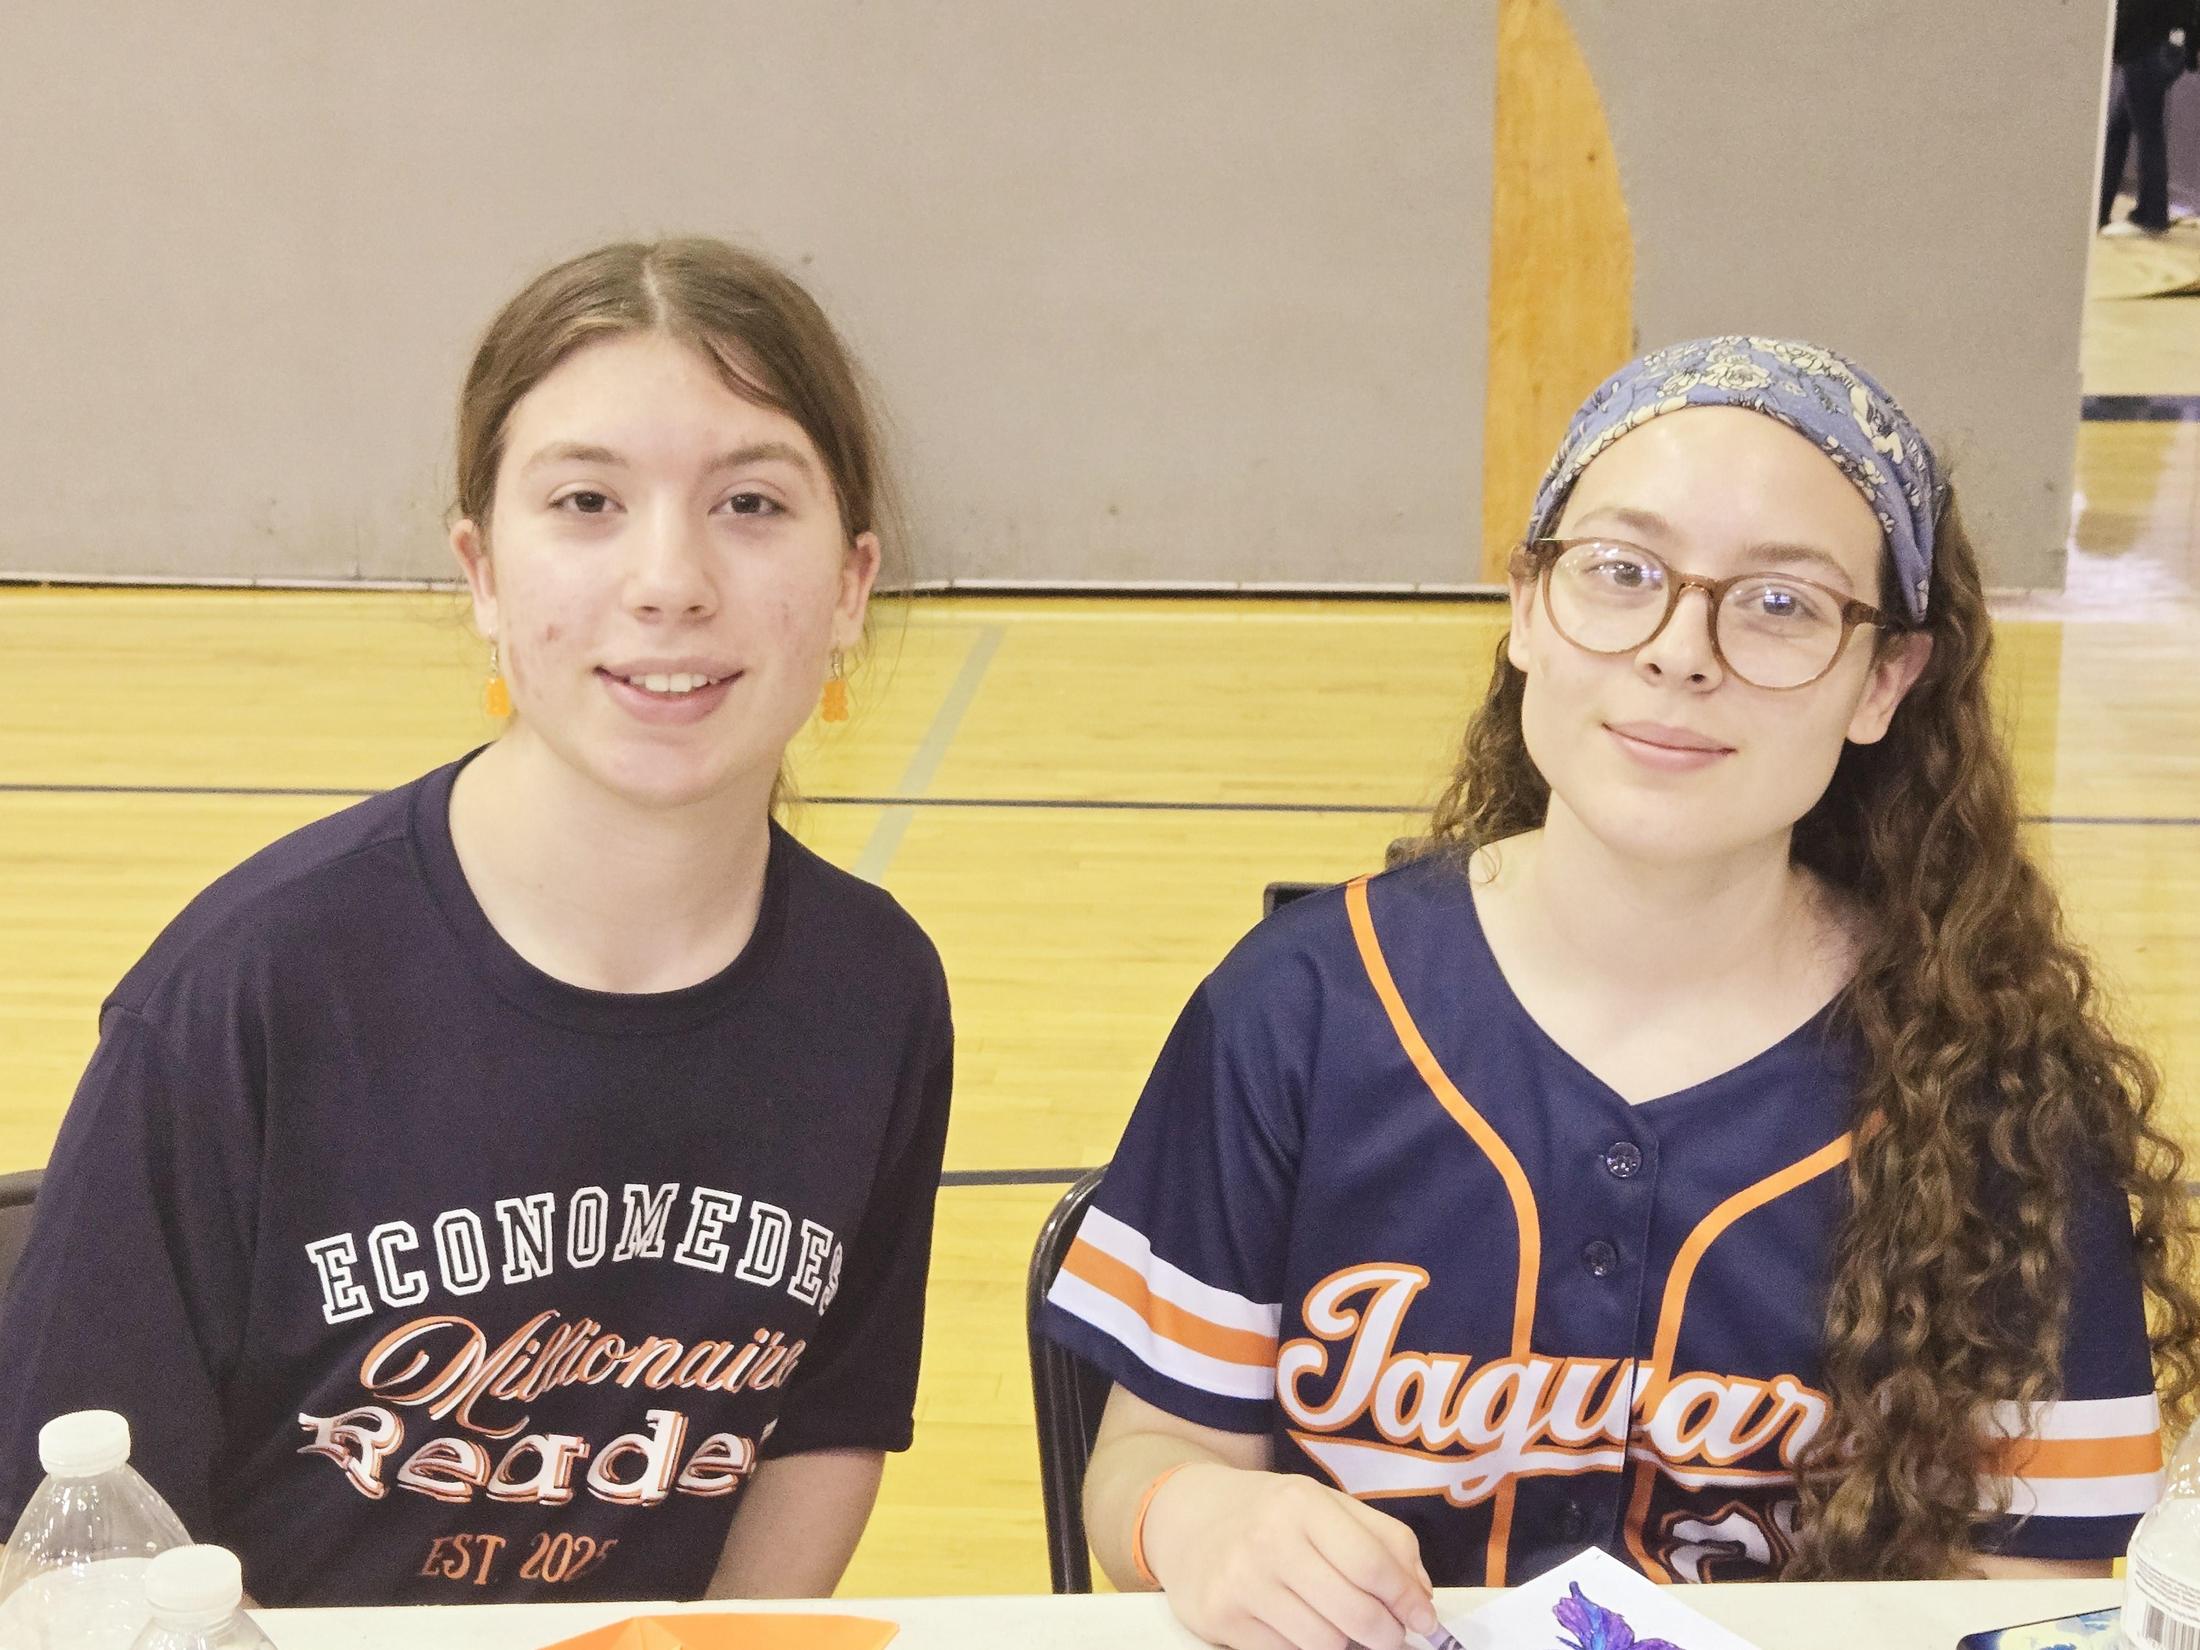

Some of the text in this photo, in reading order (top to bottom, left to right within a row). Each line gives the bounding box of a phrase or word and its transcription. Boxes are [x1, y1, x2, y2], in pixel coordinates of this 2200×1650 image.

[1276, 1262, 1836, 1508] Jaguar
[296, 1405, 779, 1506] Reade
[419, 1533, 508, 1585] EST
